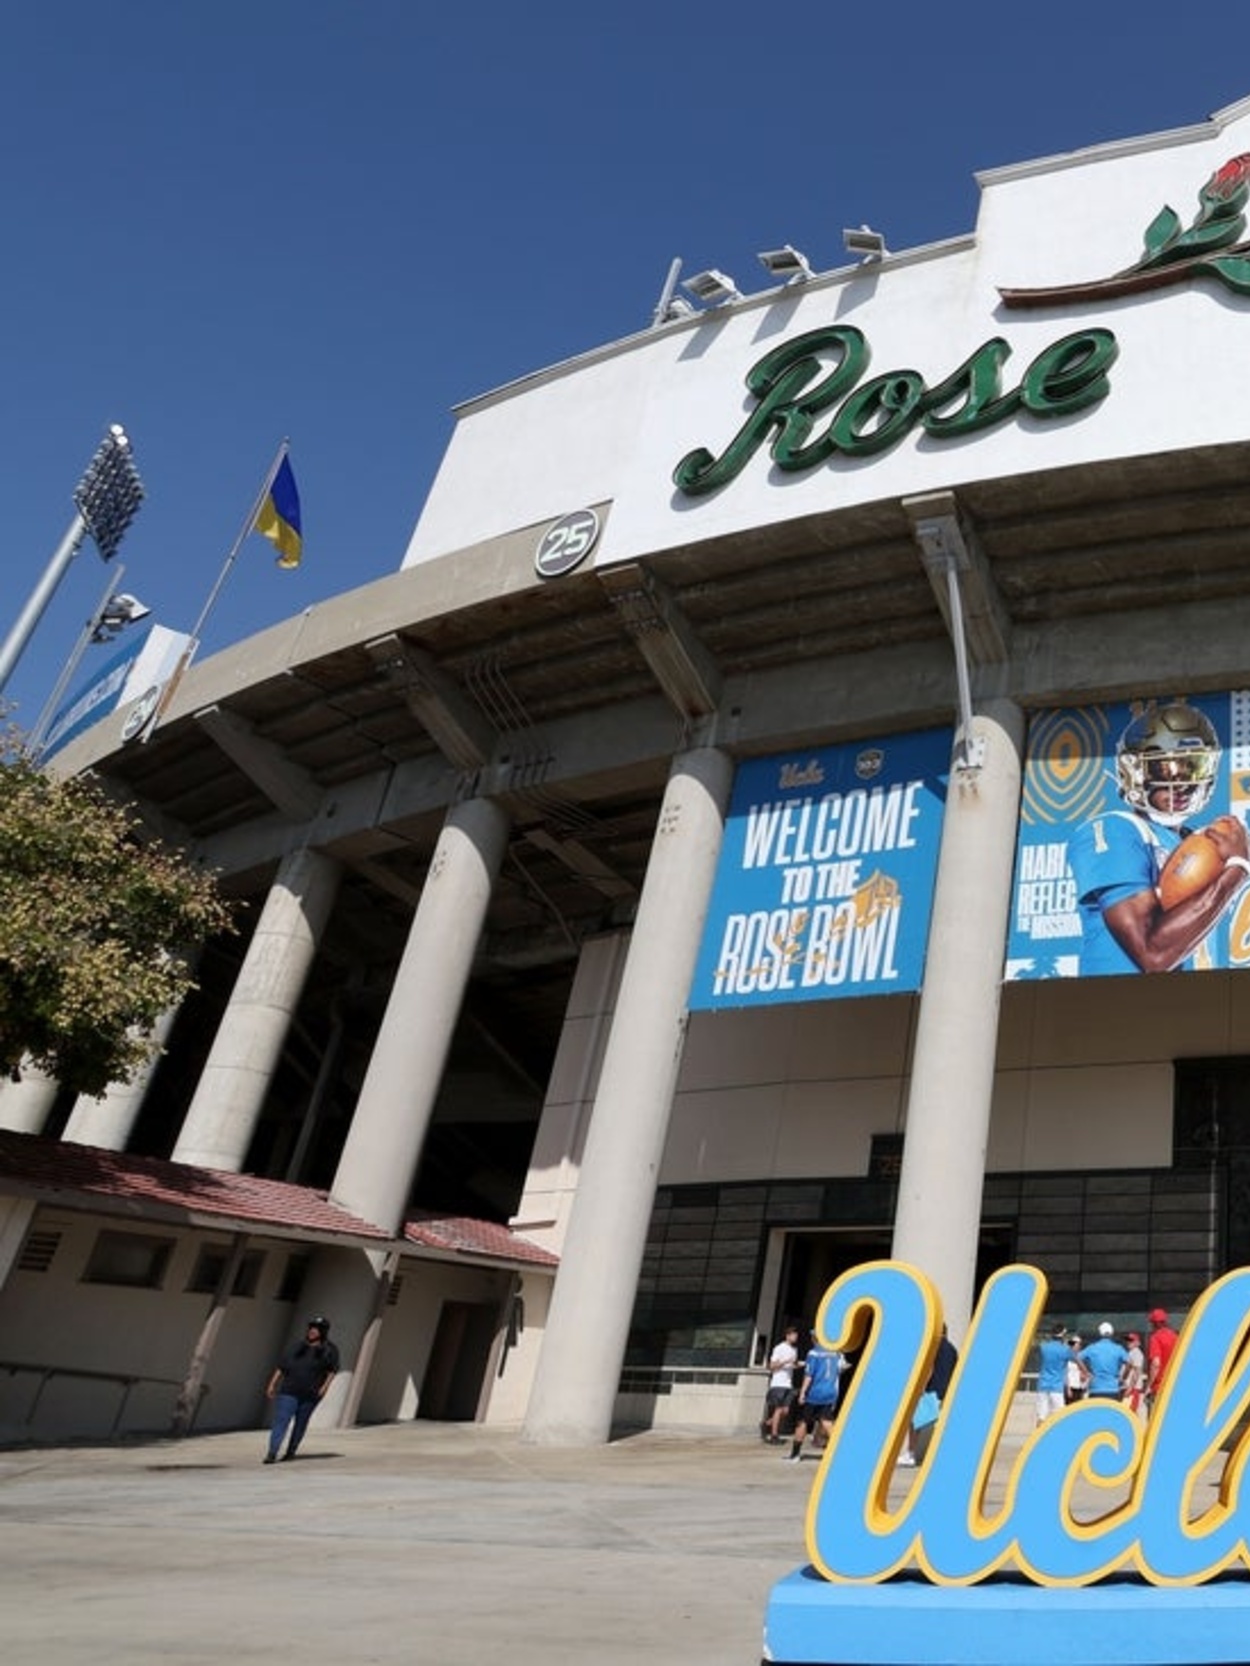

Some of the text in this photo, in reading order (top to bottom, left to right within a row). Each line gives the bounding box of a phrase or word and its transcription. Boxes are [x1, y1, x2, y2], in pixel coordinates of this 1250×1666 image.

[672, 325, 1119, 496] Rose
[540, 519, 594, 562] 25
[742, 780, 925, 869] WELCOME
[781, 859, 863, 905] TO THE
[713, 896, 901, 996] ROSE BOWL
